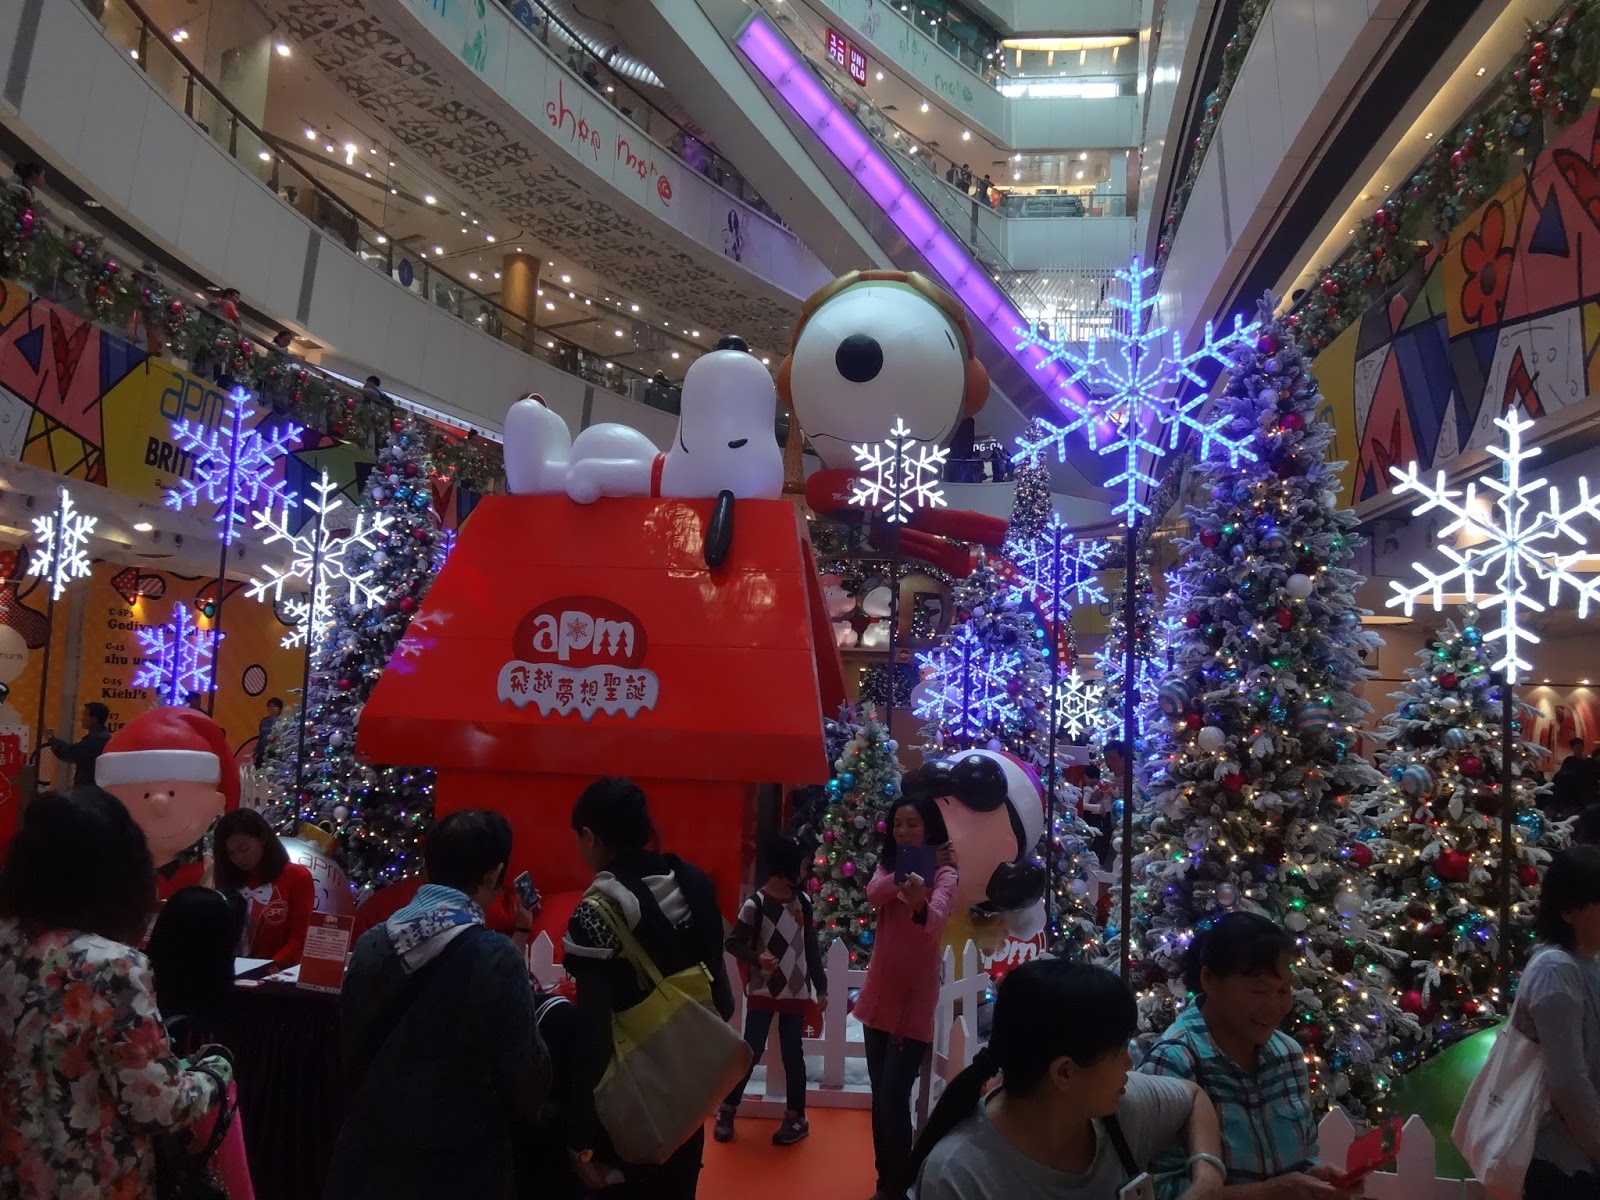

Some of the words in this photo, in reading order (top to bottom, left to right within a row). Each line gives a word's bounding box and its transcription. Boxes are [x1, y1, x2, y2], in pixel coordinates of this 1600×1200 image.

[850, 63, 865, 81] QLO
[851, 50, 865, 69] UNI
[546, 78, 601, 161] shop
[617, 133, 672, 207] more
[160, 371, 225, 434] apm
[145, 436, 215, 482] BRITTO
[109, 608, 134, 618] C-SP3
[106, 643, 125, 651] C-13
[533, 610, 635, 661] apm
[105, 654, 128, 665] shu
[102, 688, 147, 700] Kiehl's
[103, 677, 122, 686] C-15
[510, 666, 647, 707] 飛越夢想聖誕
[298, 852, 342, 886] apm
[979, 938, 1037, 970] pm
